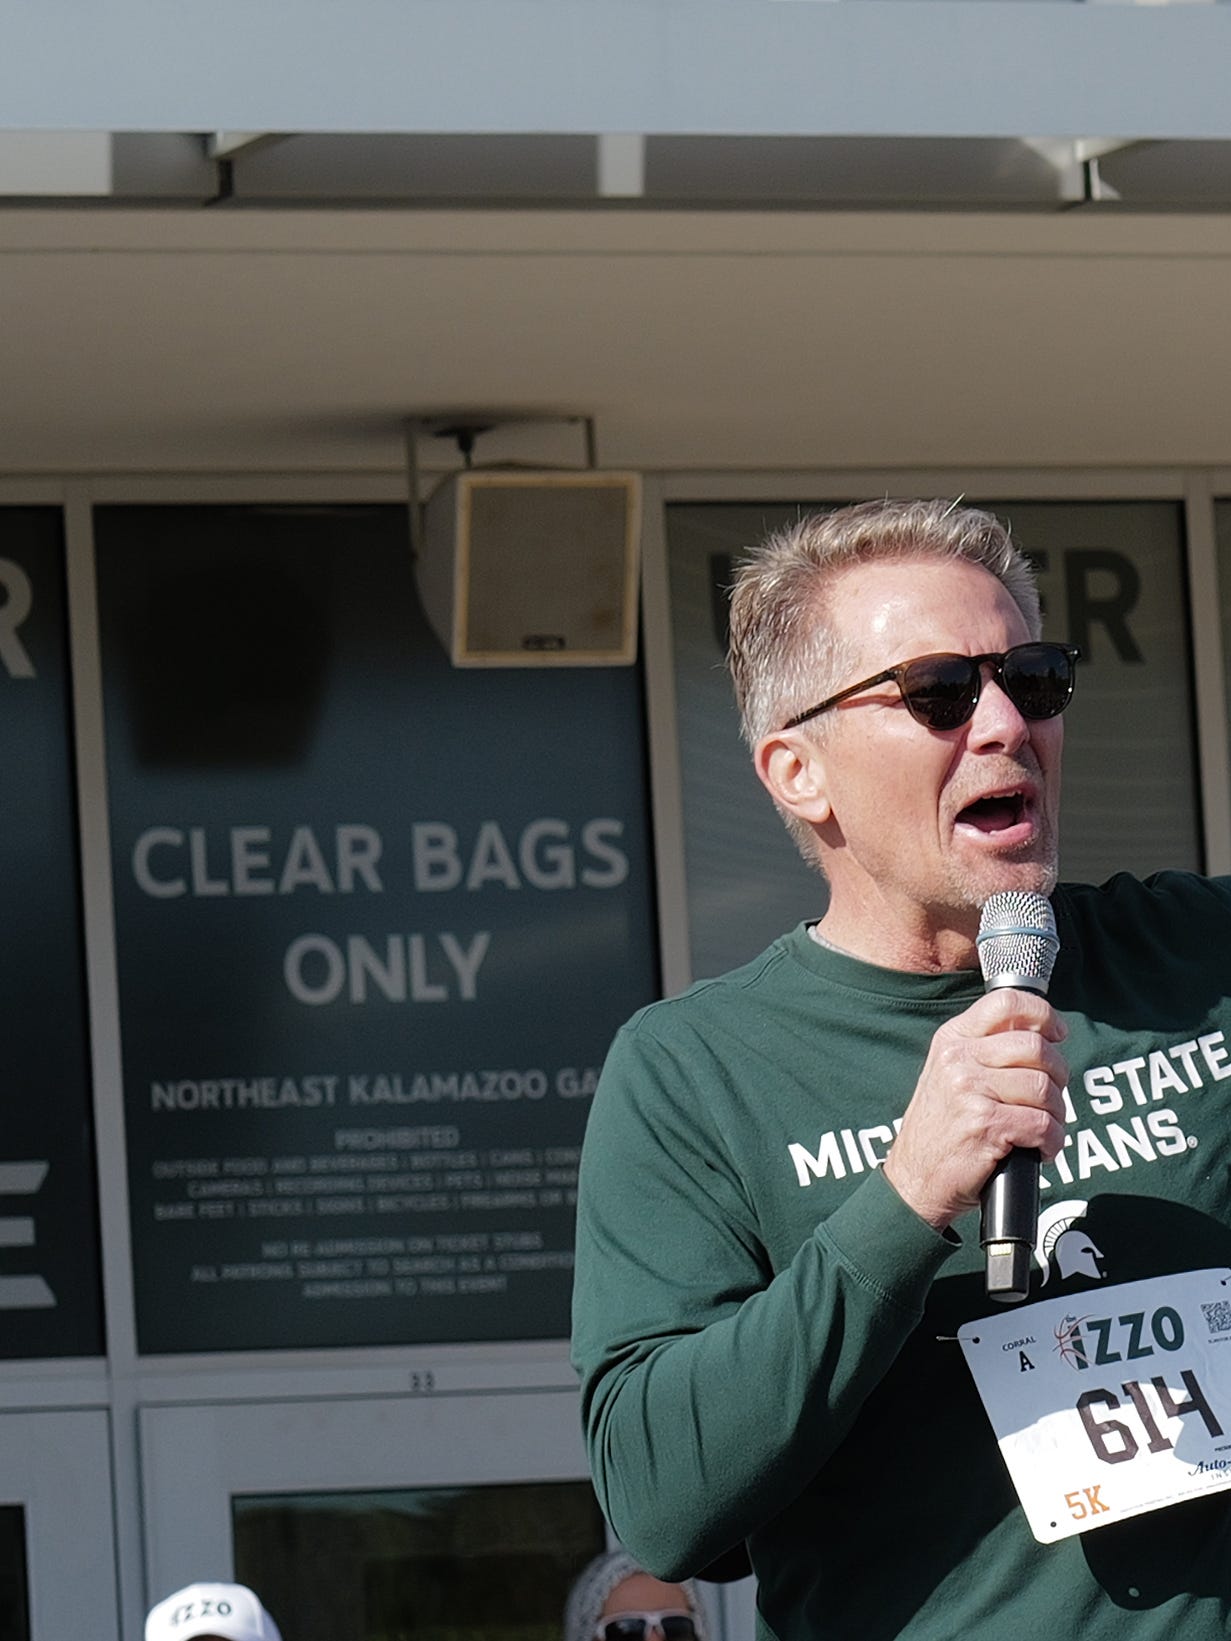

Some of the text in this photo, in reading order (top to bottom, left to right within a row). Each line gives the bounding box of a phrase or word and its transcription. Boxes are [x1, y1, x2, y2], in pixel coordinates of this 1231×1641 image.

[133, 818, 630, 898] CLEAR BAGS
[283, 932, 490, 1006] ONLY
[152, 1068, 597, 1110] NORTHEAST KALAMAZOO GA
[1002, 1336, 1037, 1352] CORRAL
[1019, 1351, 1035, 1373] A
[1068, 1306, 1185, 1370] IZZO
[1076, 1369, 1225, 1465] 614
[1064, 1484, 1111, 1521] 5K
